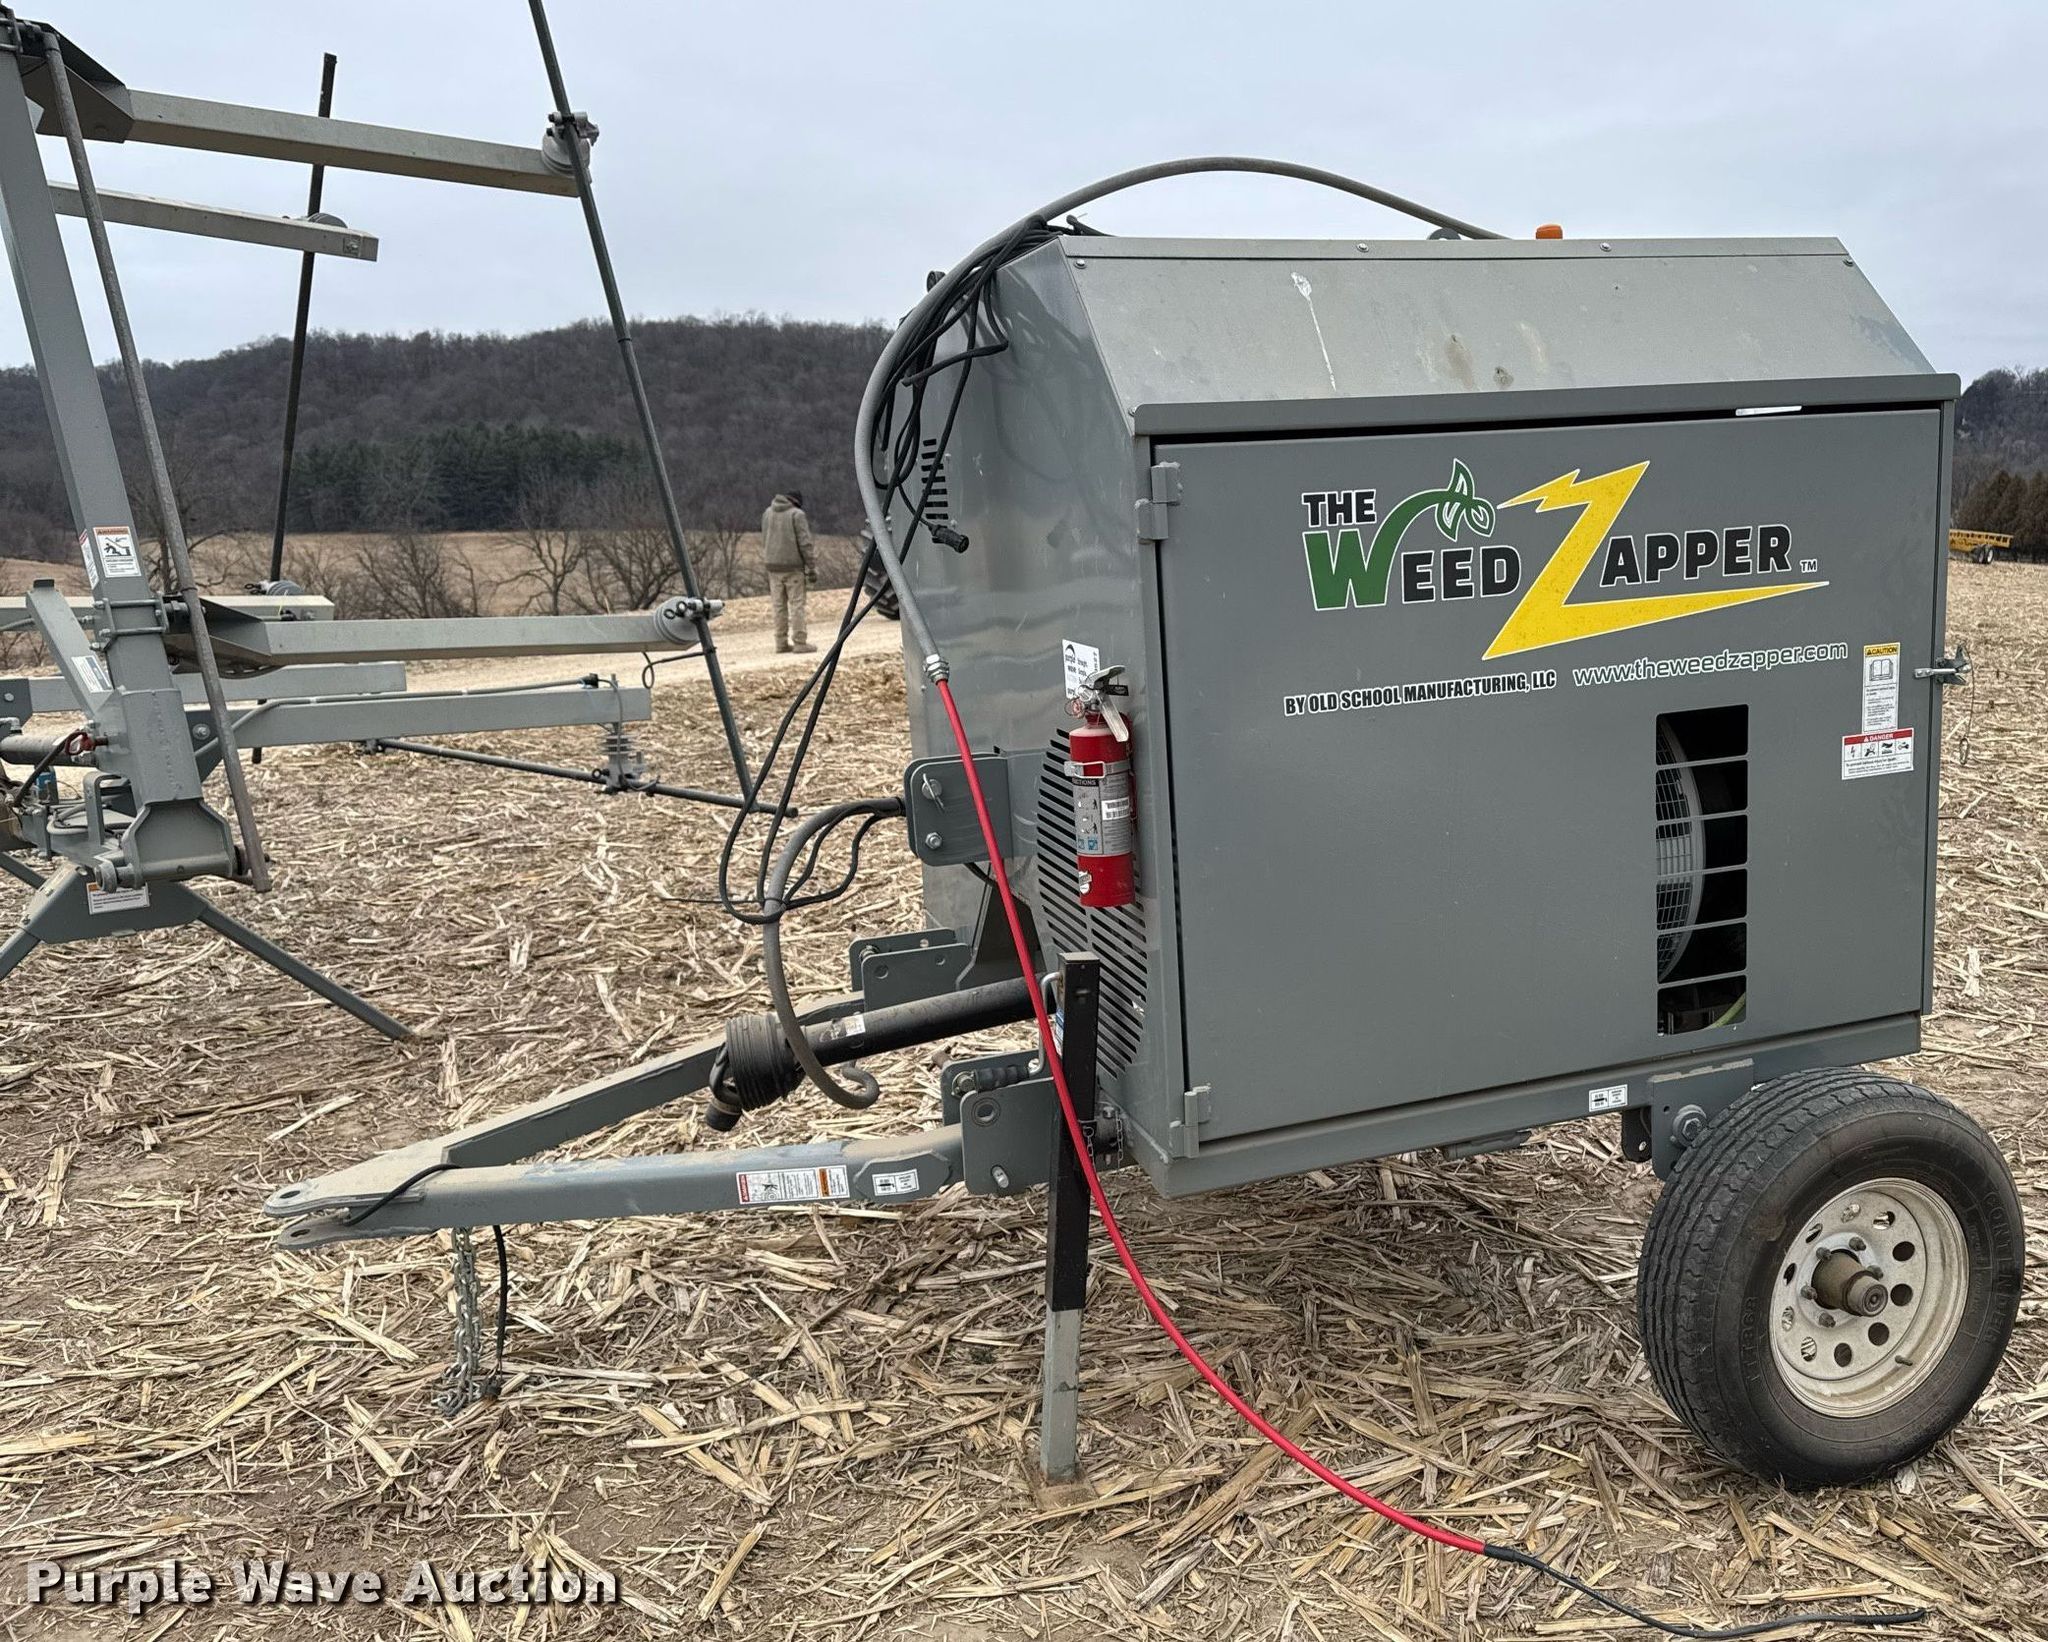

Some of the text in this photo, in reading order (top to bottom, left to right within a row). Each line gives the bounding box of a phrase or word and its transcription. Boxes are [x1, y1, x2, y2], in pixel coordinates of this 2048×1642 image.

[1301, 489, 1377, 527] THE
[1302, 460, 1829, 661] WEED ZAPPER TM
[1572, 641, 1848, 687] www.theweedzapper.com
[1284, 669, 1557, 716] BY OLD SCHOOL MANUFACTURING, LLC
